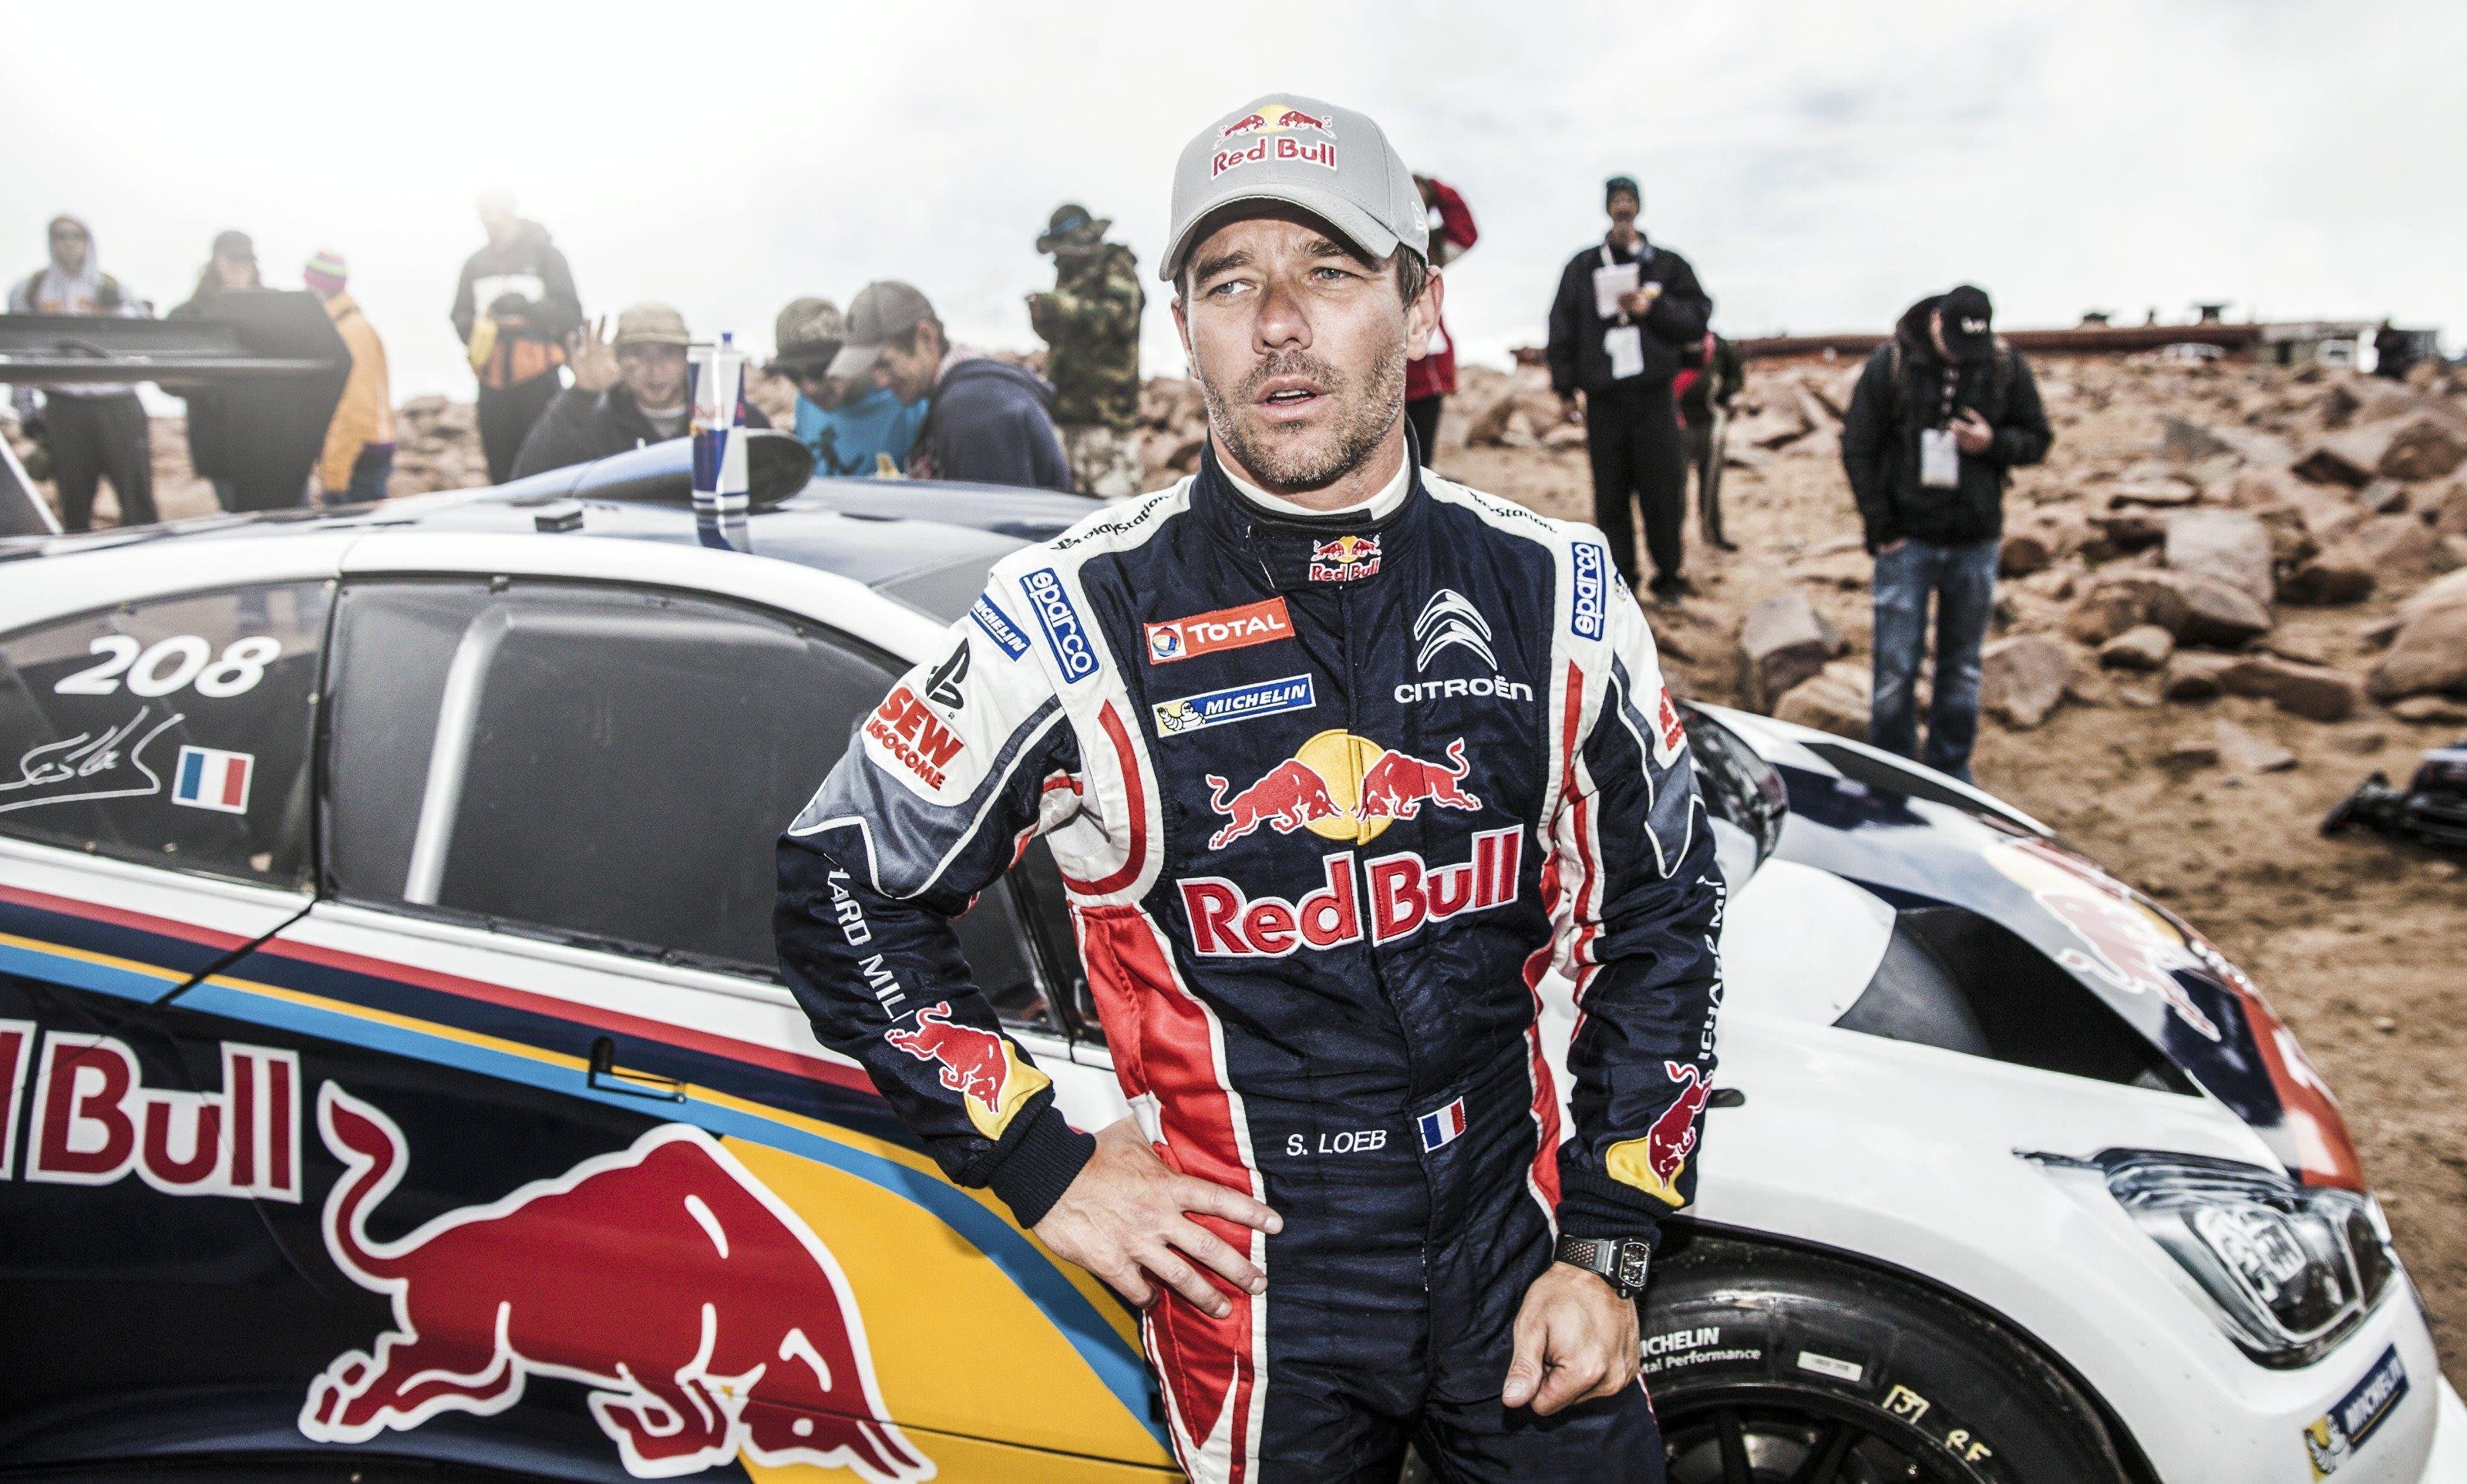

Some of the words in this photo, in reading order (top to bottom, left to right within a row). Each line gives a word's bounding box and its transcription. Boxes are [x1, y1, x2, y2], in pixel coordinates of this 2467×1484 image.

[1212, 138, 1267, 179] Red
[1276, 137, 1336, 169] Bull
[1310, 564, 1347, 580] Red
[1349, 558, 1380, 580] Bull
[1575, 543, 1604, 634] sparco
[1029, 572, 1092, 673] sparco
[1186, 613, 1286, 644] TOTAL
[54, 634, 281, 698] 208
[1204, 683, 1307, 716] MICHELIN
[877, 686, 965, 769] SEW
[1180, 854, 1361, 955] Red
[1367, 827, 1522, 944] Bull
[32, 1037, 297, 1198] Bull
[1286, 1134, 1308, 1156] S.
[1318, 1129, 1387, 1154] LOEB
[1640, 1327, 1720, 1358] ICHELIN
[1641, 1358, 1663, 1374] tal
[1665, 1349, 1762, 1369] Performance
